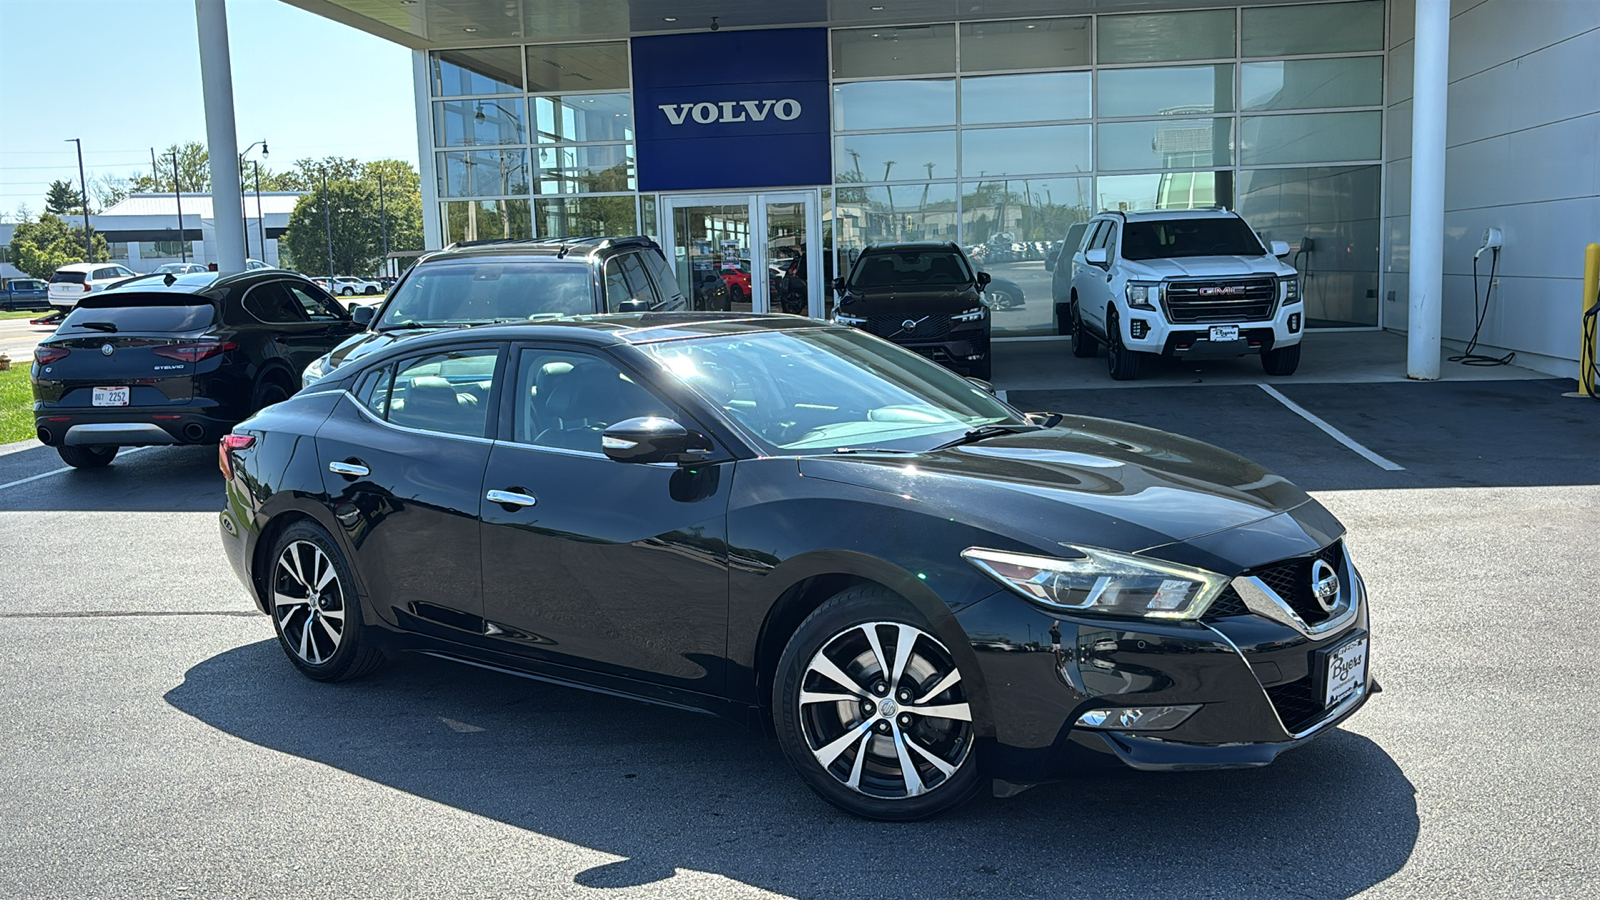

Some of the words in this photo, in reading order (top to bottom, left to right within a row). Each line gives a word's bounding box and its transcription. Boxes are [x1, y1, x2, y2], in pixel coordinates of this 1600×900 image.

[658, 98, 802, 125] VOLVO
[1199, 285, 1246, 297] GMC
[108, 391, 126, 402] 2252
[1330, 655, 1362, 681] Byers
